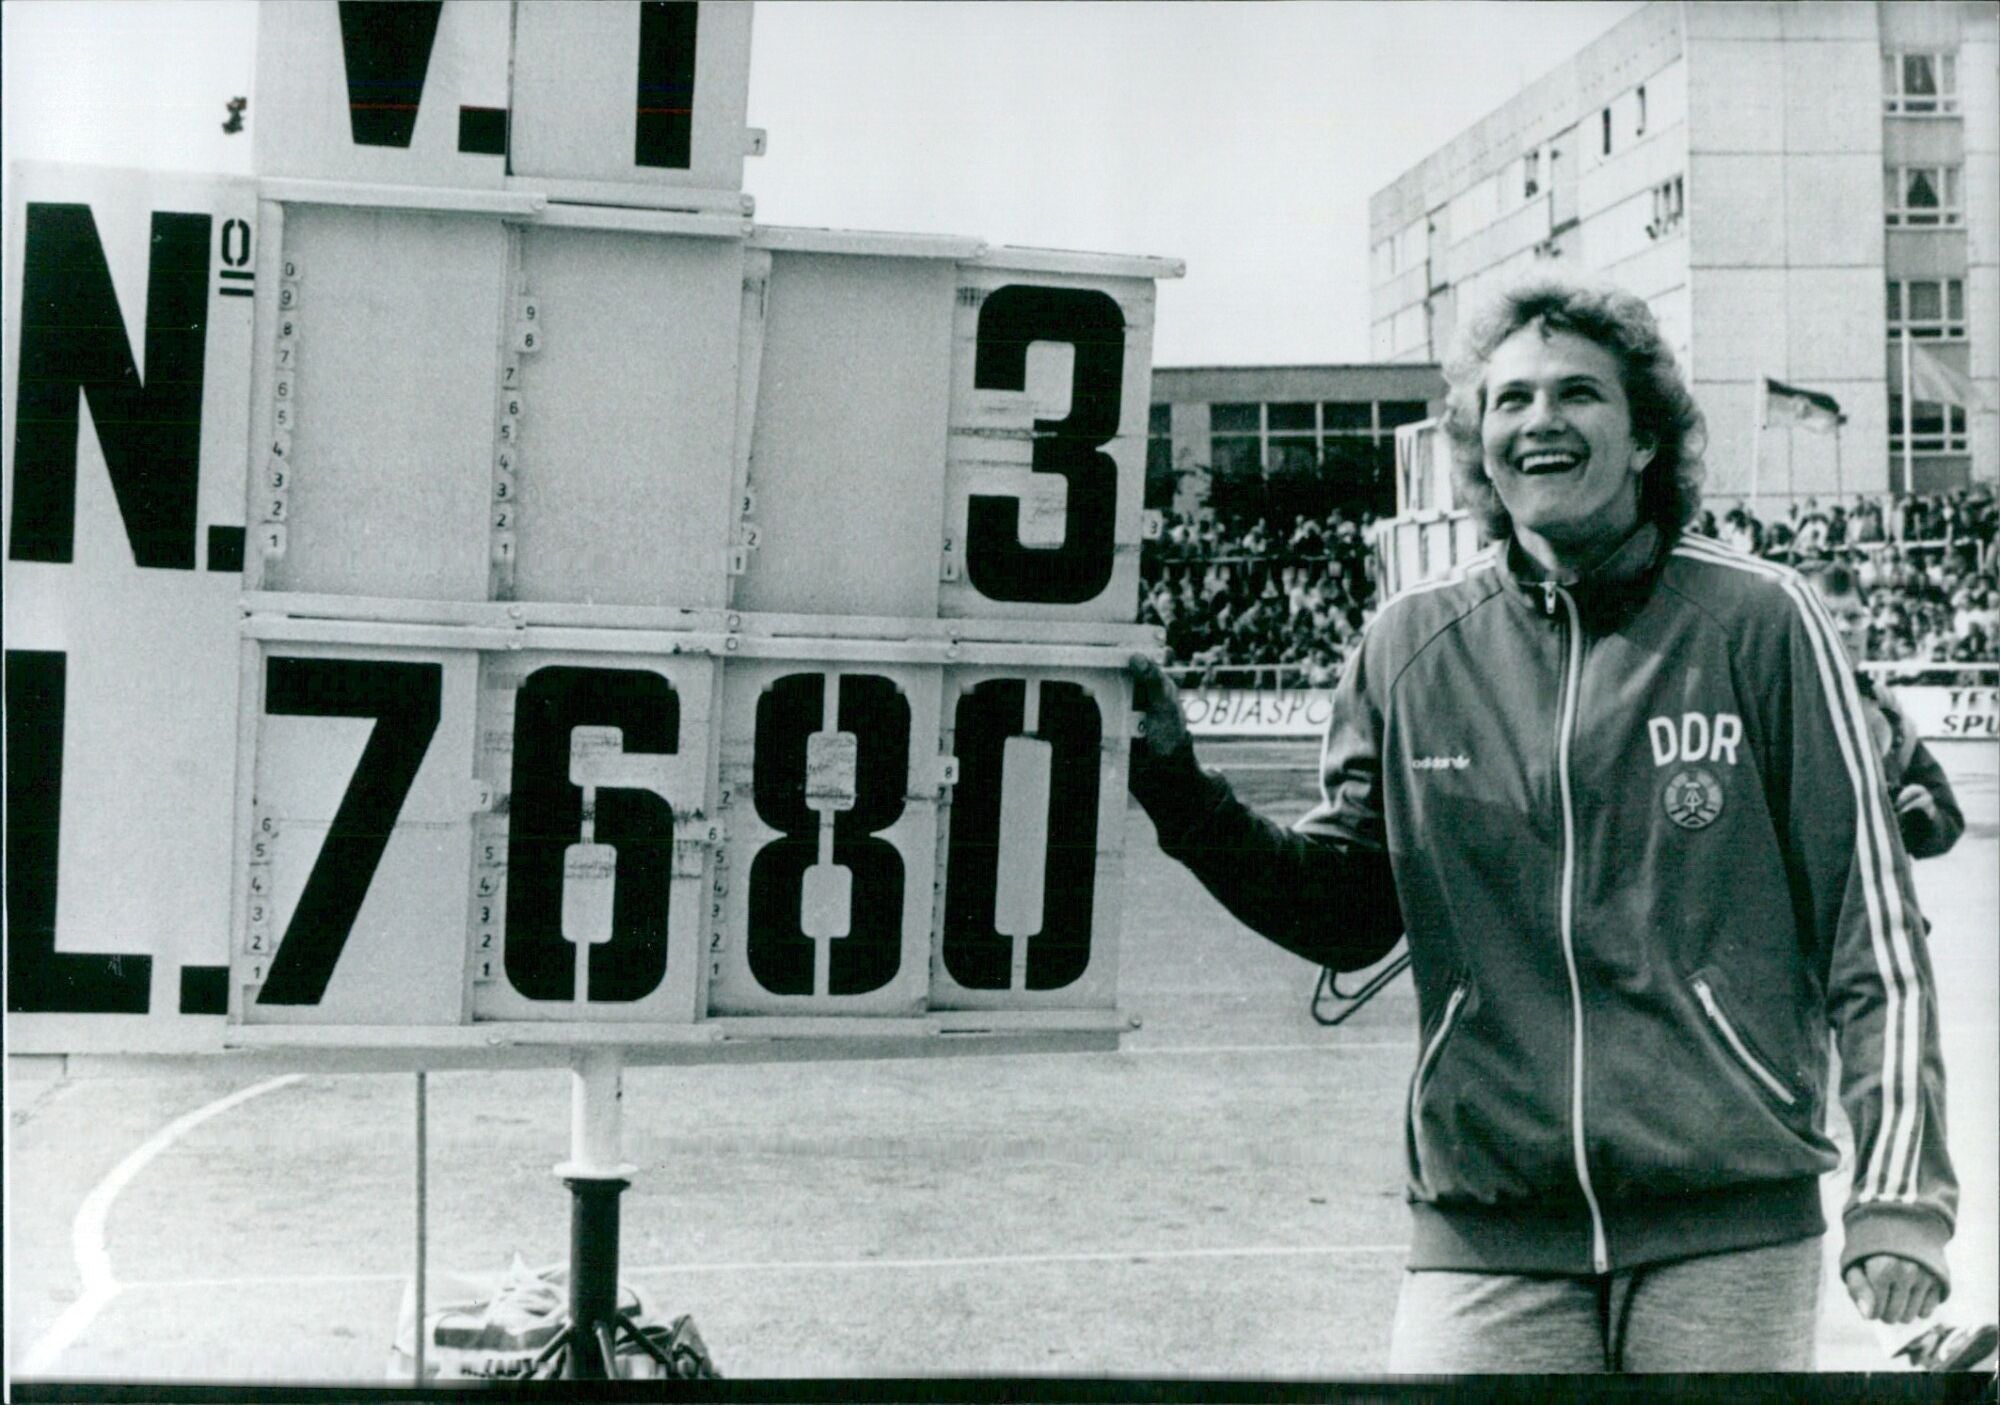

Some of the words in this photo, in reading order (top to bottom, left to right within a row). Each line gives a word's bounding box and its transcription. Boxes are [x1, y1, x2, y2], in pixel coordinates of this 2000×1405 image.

[752, 137, 761, 152] 1
[526, 305, 536, 320] 9
[283, 320, 293, 336] 8
[524, 332, 534, 348] 8
[280, 348, 290, 363] 7
[505, 366, 515, 381] 7
[277, 381, 288, 397] 6
[509, 400, 519, 416] 6
[277, 410, 287, 425] 5
[501, 424, 511, 440] 5
[272, 441, 283, 457] 4
[965, 284, 1127, 605] 3
[499, 454, 509, 470] 4
[272, 471, 283, 488] 3
[496, 482, 507, 498] 3
[272, 500, 283, 516] 2
[496, 513, 507, 528] 2
[270, 533, 278, 548] 1
[747, 531, 757, 546] 2
[943, 538, 952, 552] 2
[501, 543, 509, 555] 1
[1648, 711, 1742, 767] DDR
[944, 765, 954, 780] 8
[5, 649, 230, 1014] L.
[261, 817, 272, 832] 6
[255, 843, 265, 858] 5
[485, 845, 494, 860] 5
[715, 849, 725, 864] 5
[251, 876, 262, 892] 4
[480, 877, 490, 892] 4
[252, 906, 263, 922] 3
[480, 906, 490, 923] 3
[251, 935, 262, 951] 2
[481, 933, 492, 949] 2
[711, 932, 721, 949] 2
[254, 966, 261, 979] 1
[483, 962, 490, 977] 1
[712, 962, 720, 976] 1
